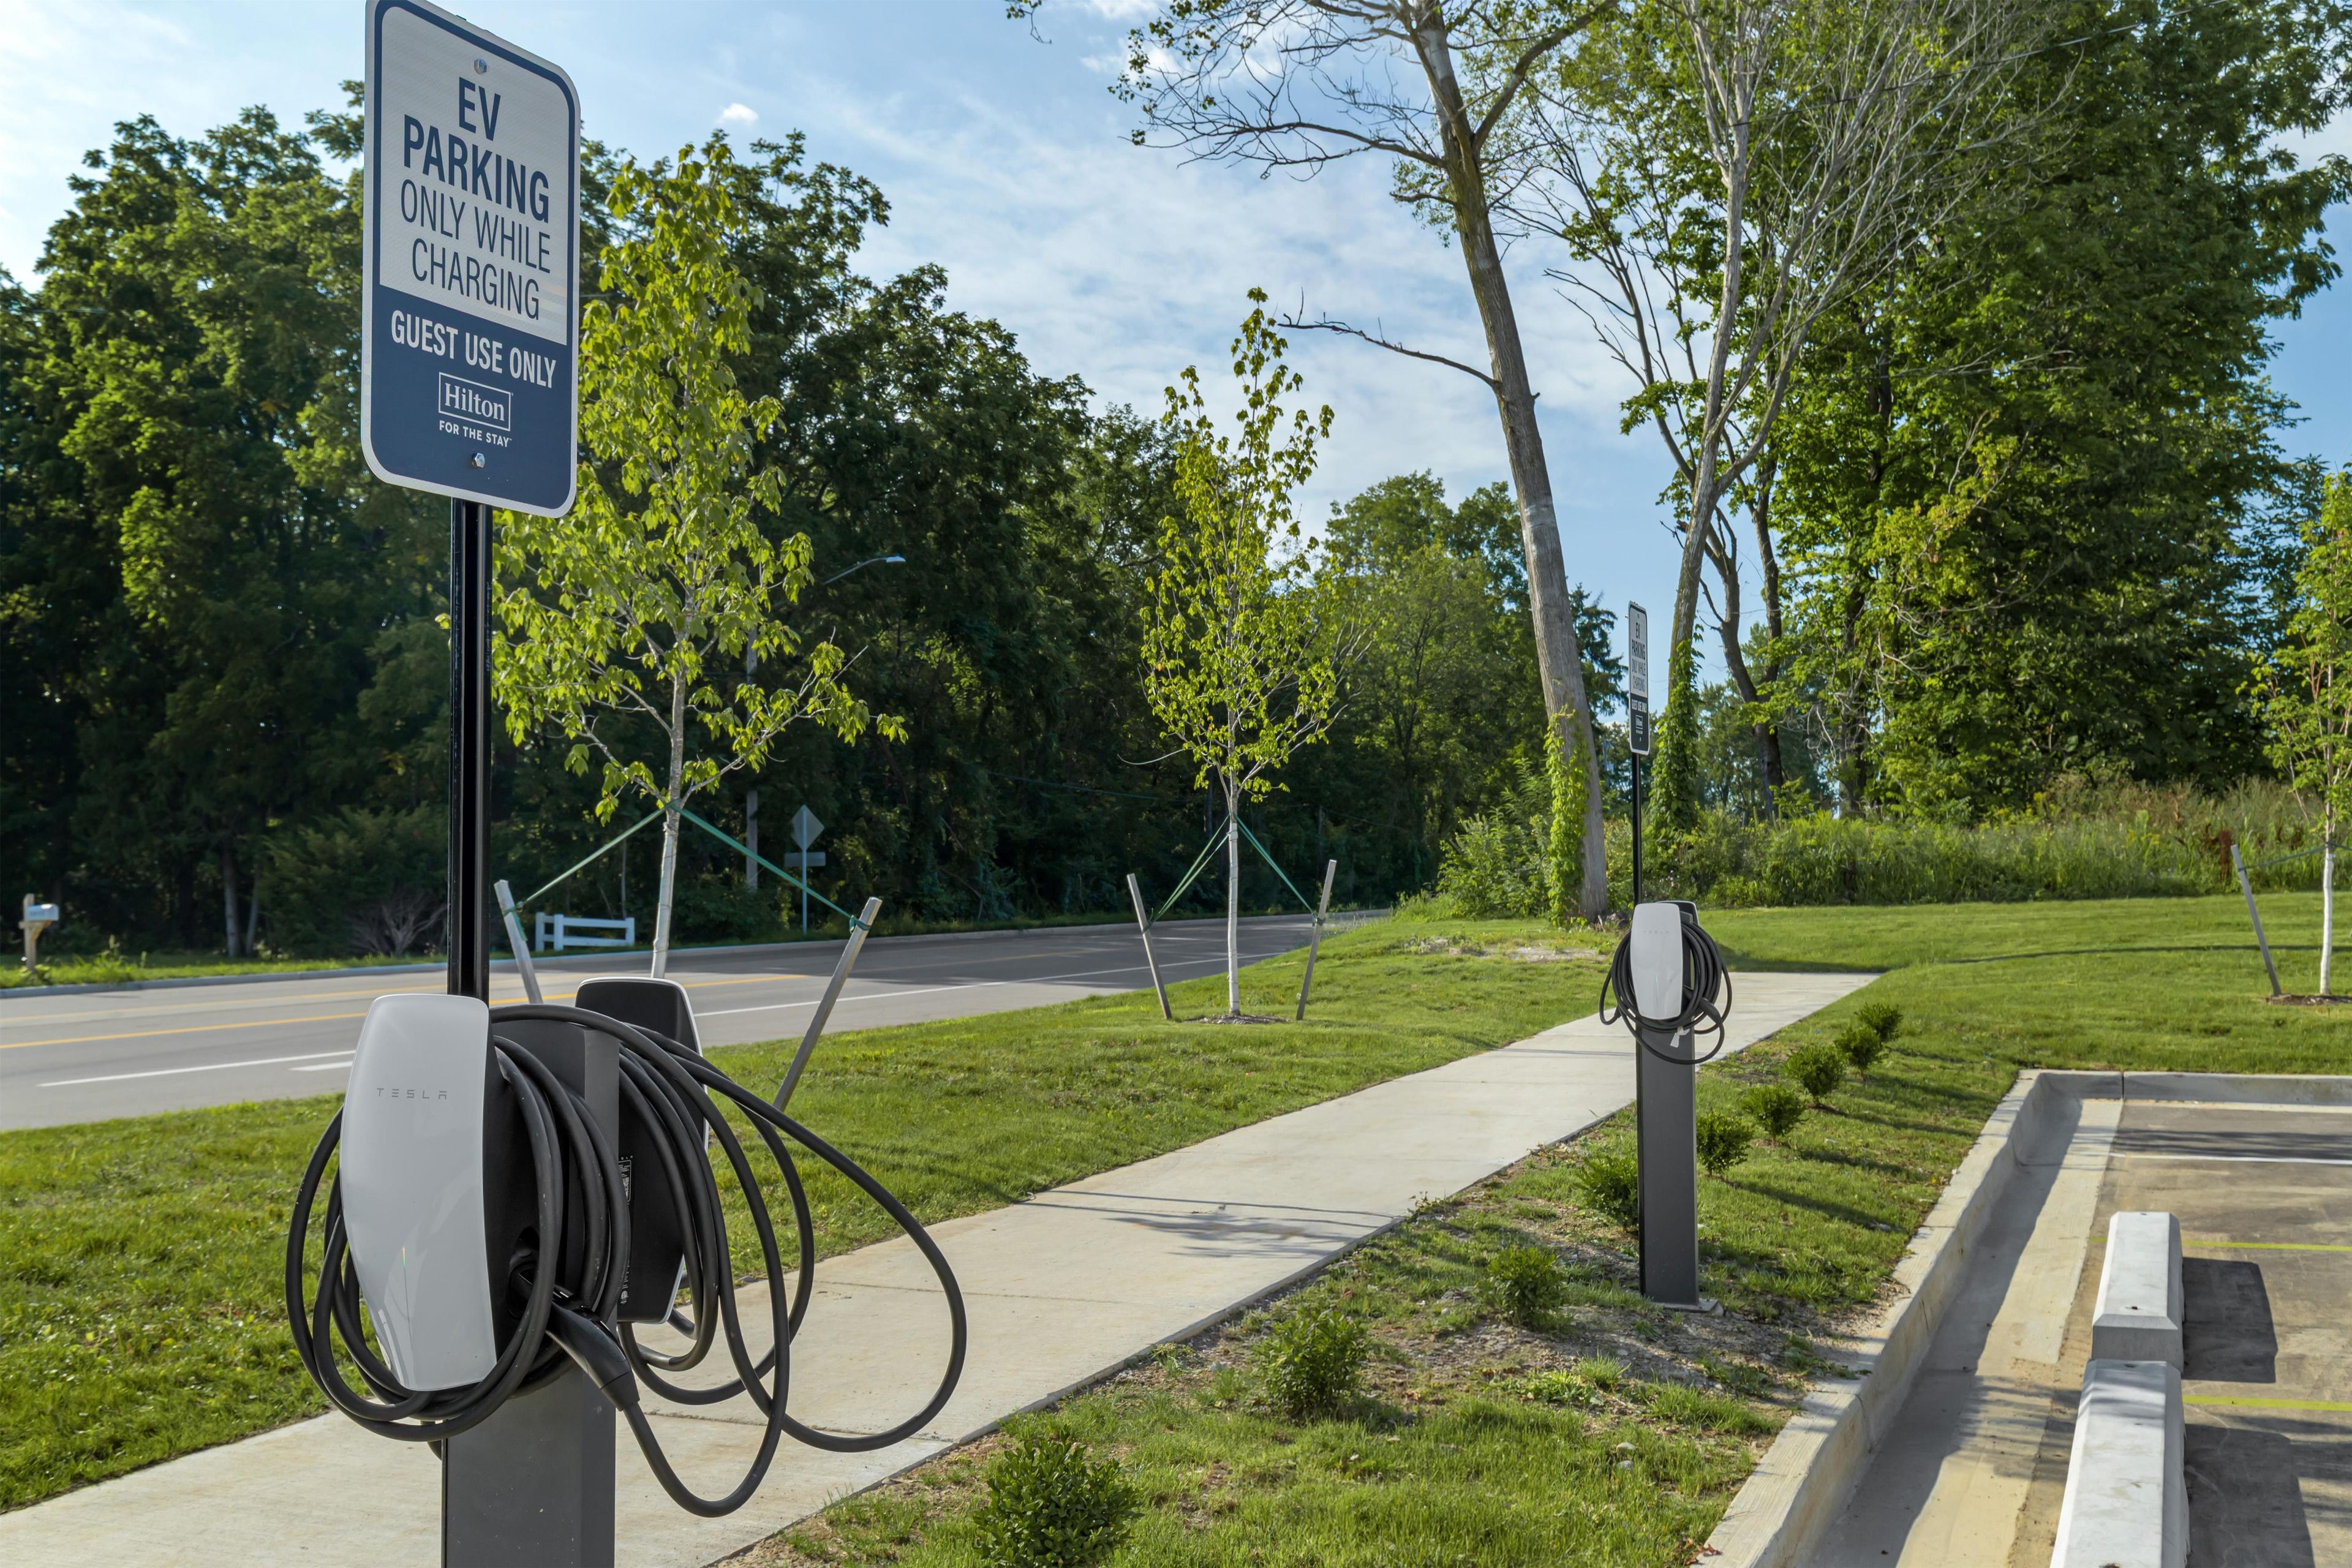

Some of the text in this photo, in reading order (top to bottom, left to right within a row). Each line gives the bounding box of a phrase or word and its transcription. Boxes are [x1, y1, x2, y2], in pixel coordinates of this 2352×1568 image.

[459, 77, 501, 141] EV
[404, 114, 549, 224] PARKING
[401, 179, 551, 274] ONLY WHILE
[412, 238, 539, 320] CHARGING
[391, 310, 556, 388] GUEST USE ONLY
[439, 420, 459, 435] FOR
[462, 426, 483, 441] THE
[445, 382, 505, 421] Hilton
[377, 1088, 447, 1100] TESLA
